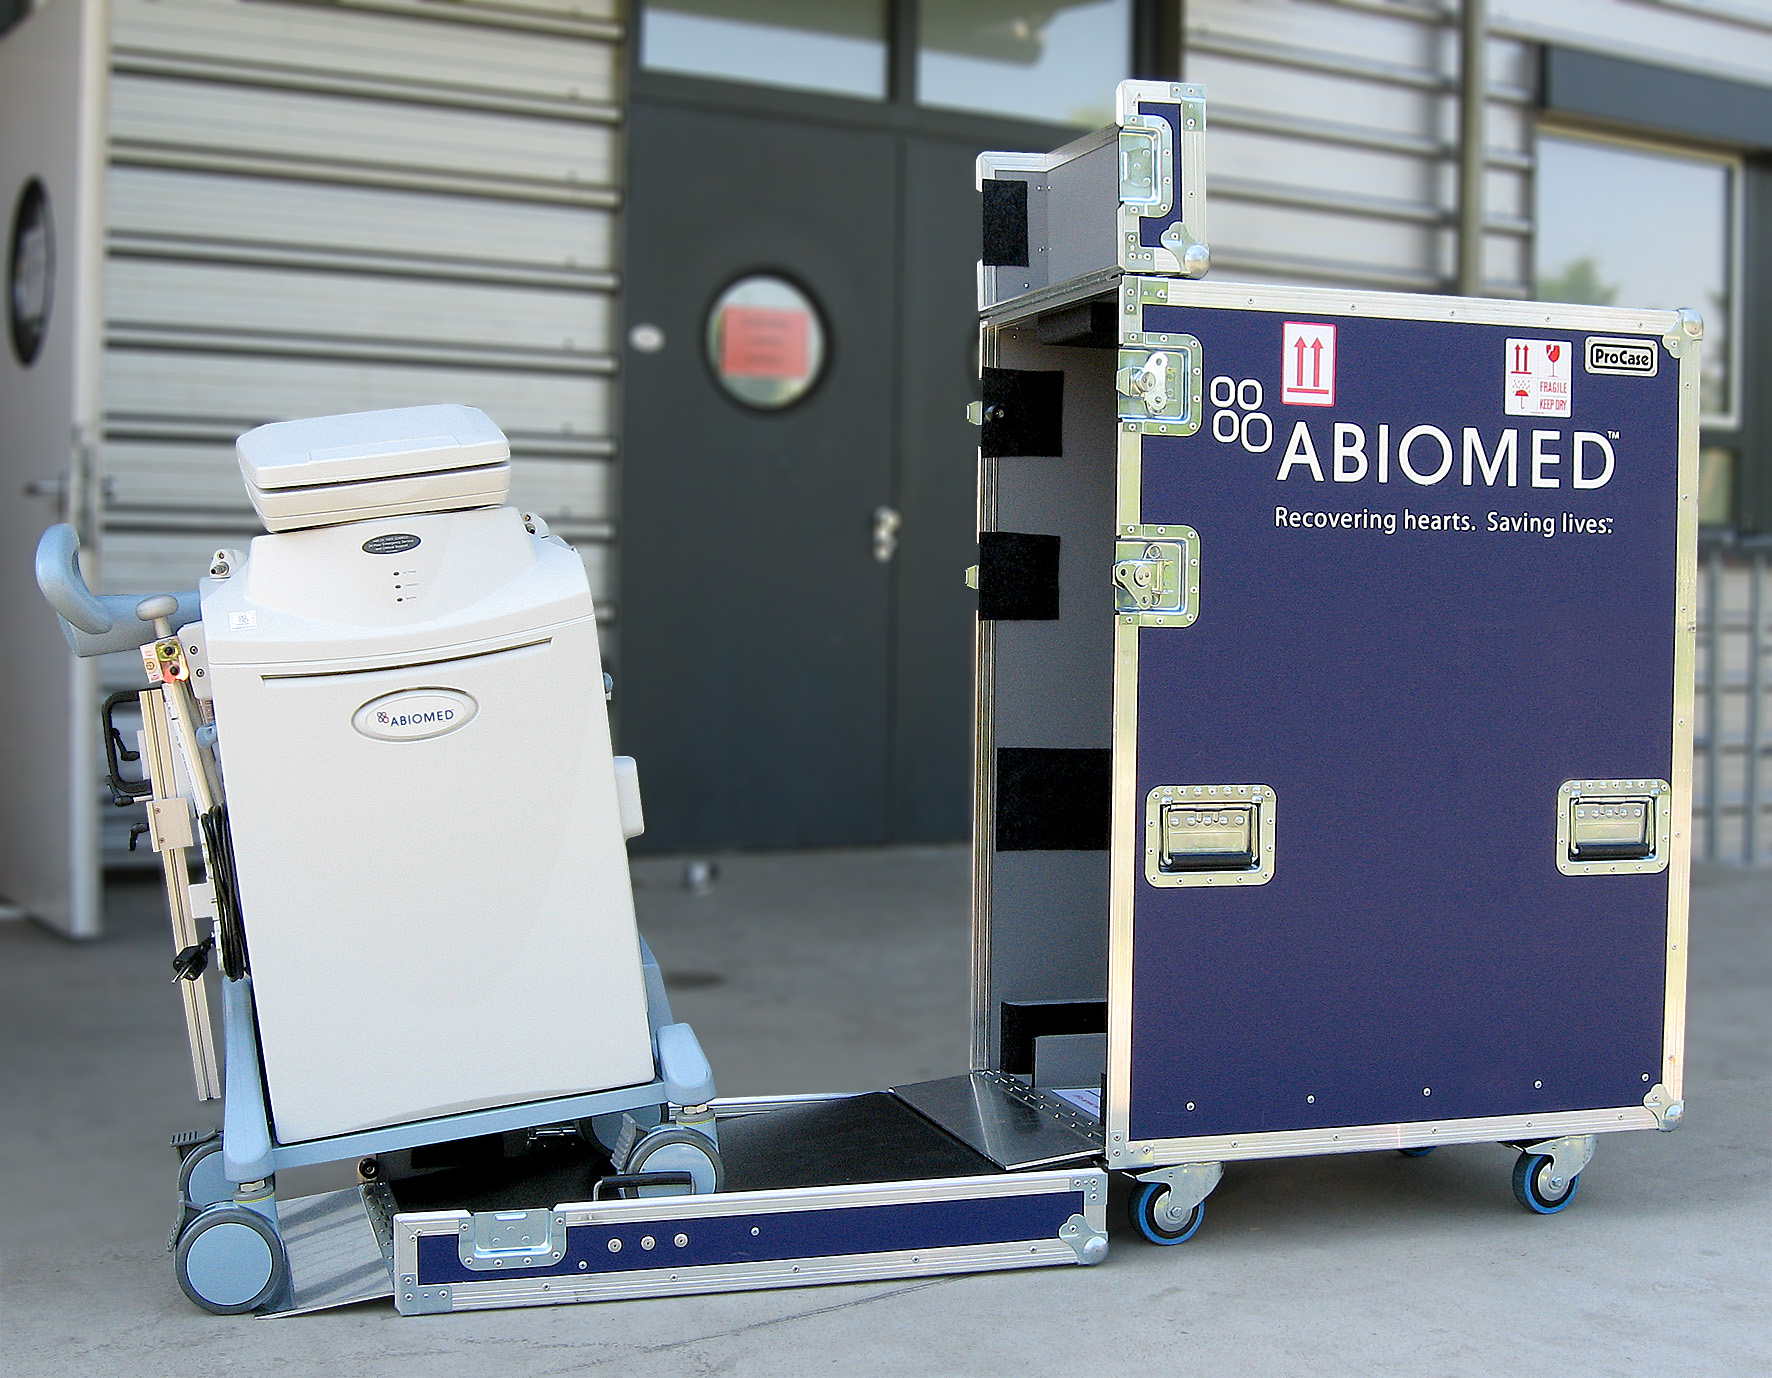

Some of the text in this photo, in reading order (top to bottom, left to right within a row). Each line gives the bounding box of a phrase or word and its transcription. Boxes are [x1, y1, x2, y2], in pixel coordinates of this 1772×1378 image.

[1595, 348, 1649, 366] ProCase
[1540, 381, 1567, 394] FRAGILE
[1540, 399, 1567, 411] KEEP DRY
[1276, 421, 1616, 489] ABIOMED
[1275, 506, 1397, 535] Recovering
[1404, 508, 1477, 532] hearts.
[1486, 511, 1556, 538] Saving
[390, 709, 454, 727] ABIOMED
